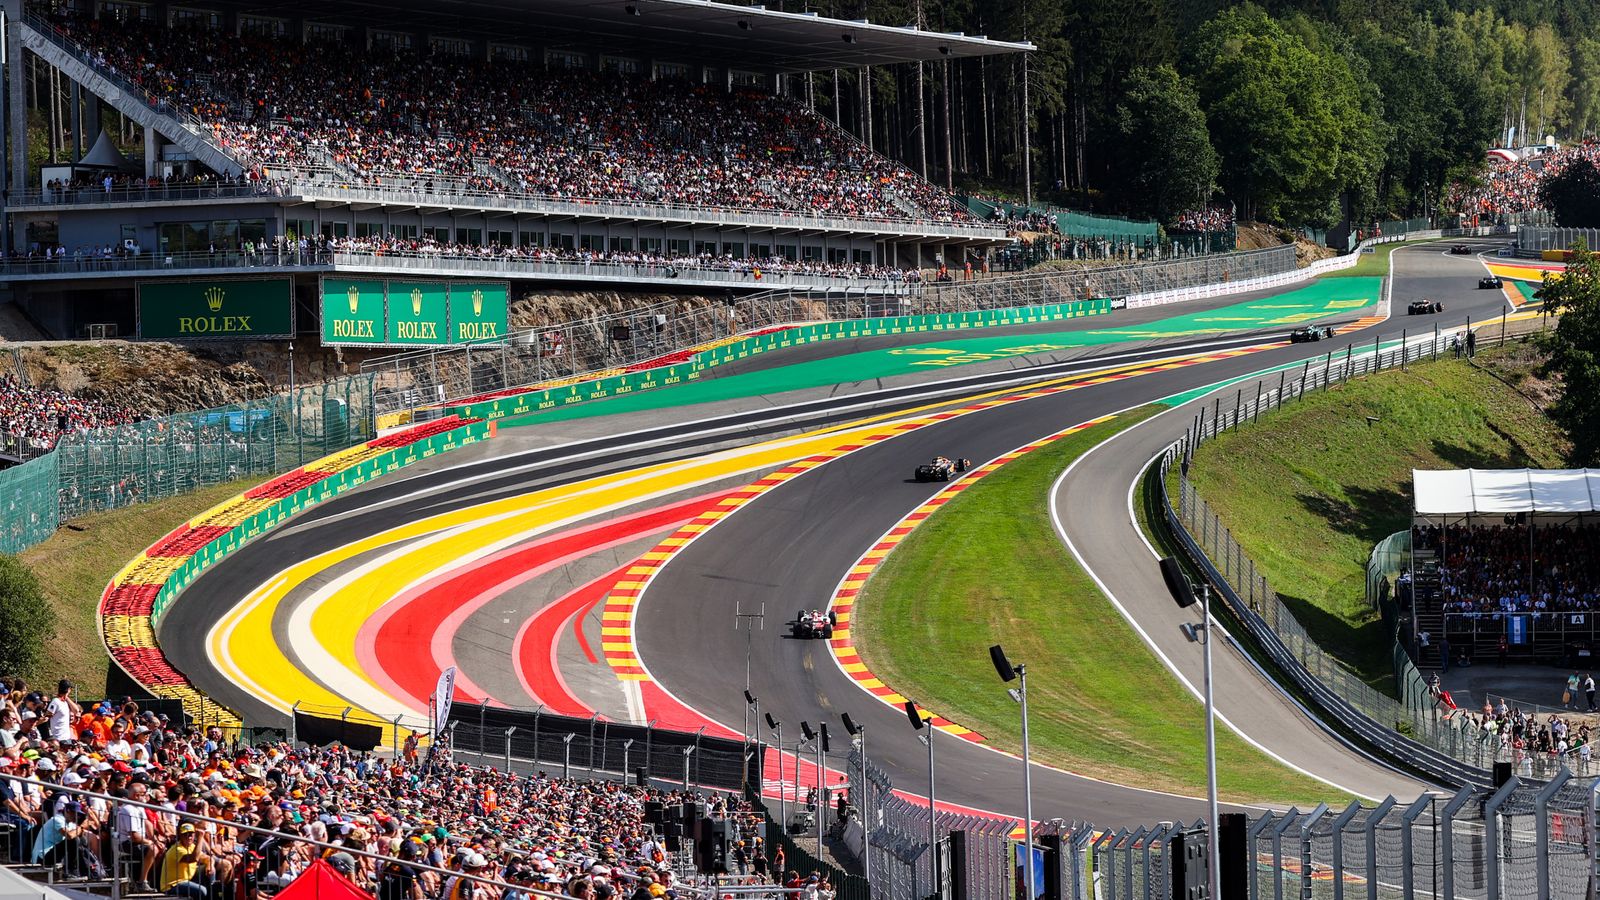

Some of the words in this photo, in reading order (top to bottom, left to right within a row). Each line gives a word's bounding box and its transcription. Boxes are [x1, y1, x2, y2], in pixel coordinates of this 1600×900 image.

[178, 316, 252, 333] ROLEX
[333, 319, 374, 338] ROLEX
[397, 321, 437, 339] ROLEX
[459, 322, 497, 339] ROLEX
[590, 390, 607, 399] ROLEX
[565, 395, 582, 404] ROLEX
[539, 400, 555, 409] ROLEX
[513, 406, 529, 414] ROLEX
[488, 411, 505, 419] ROLEX
